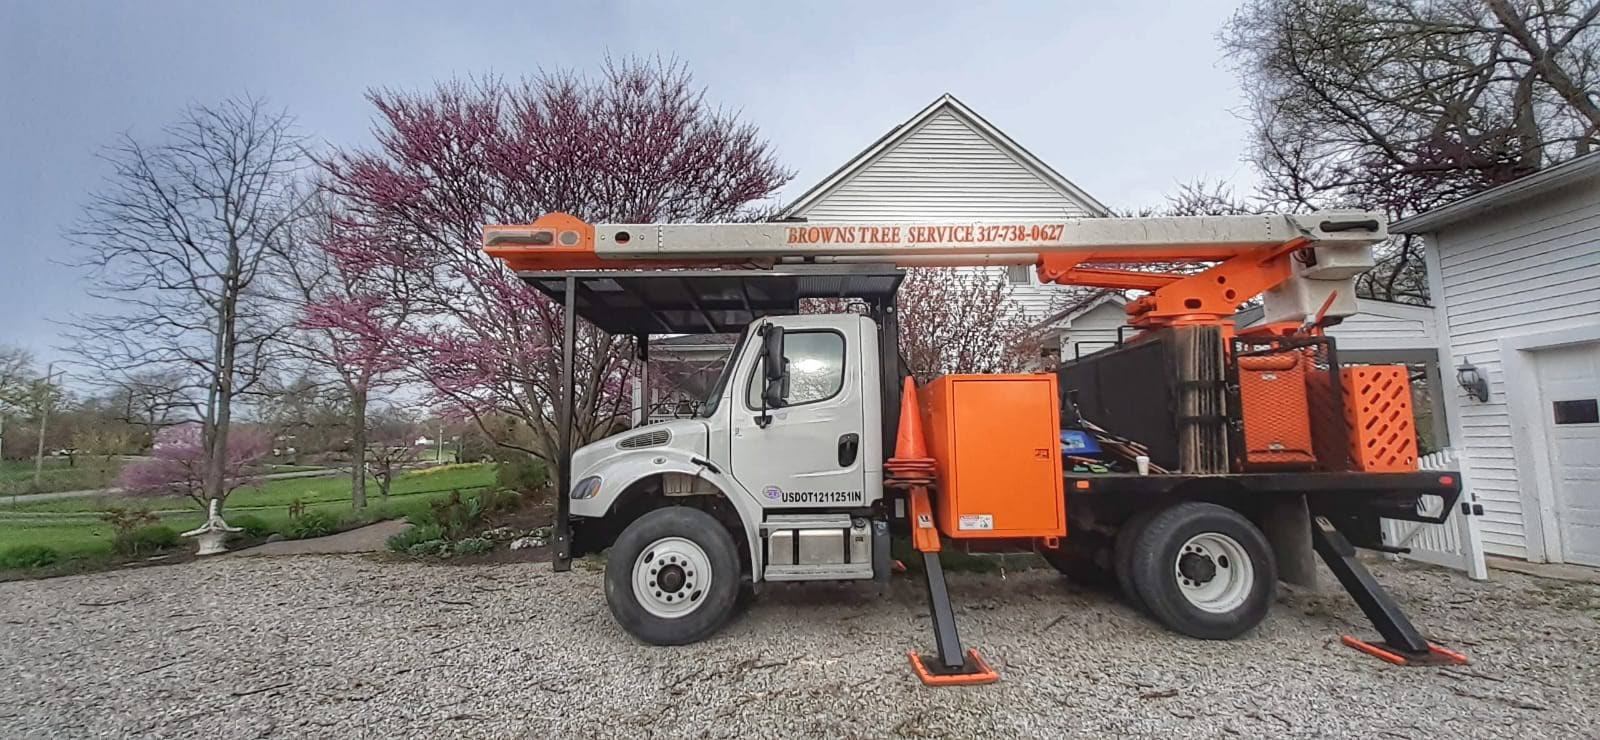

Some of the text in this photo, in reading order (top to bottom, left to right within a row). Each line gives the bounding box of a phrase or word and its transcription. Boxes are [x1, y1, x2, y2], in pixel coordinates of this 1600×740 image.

[787, 224, 1065, 243] BROWNS TREE SERVICE 317-738-0627
[781, 491, 861, 502] USDOT1211251IN
